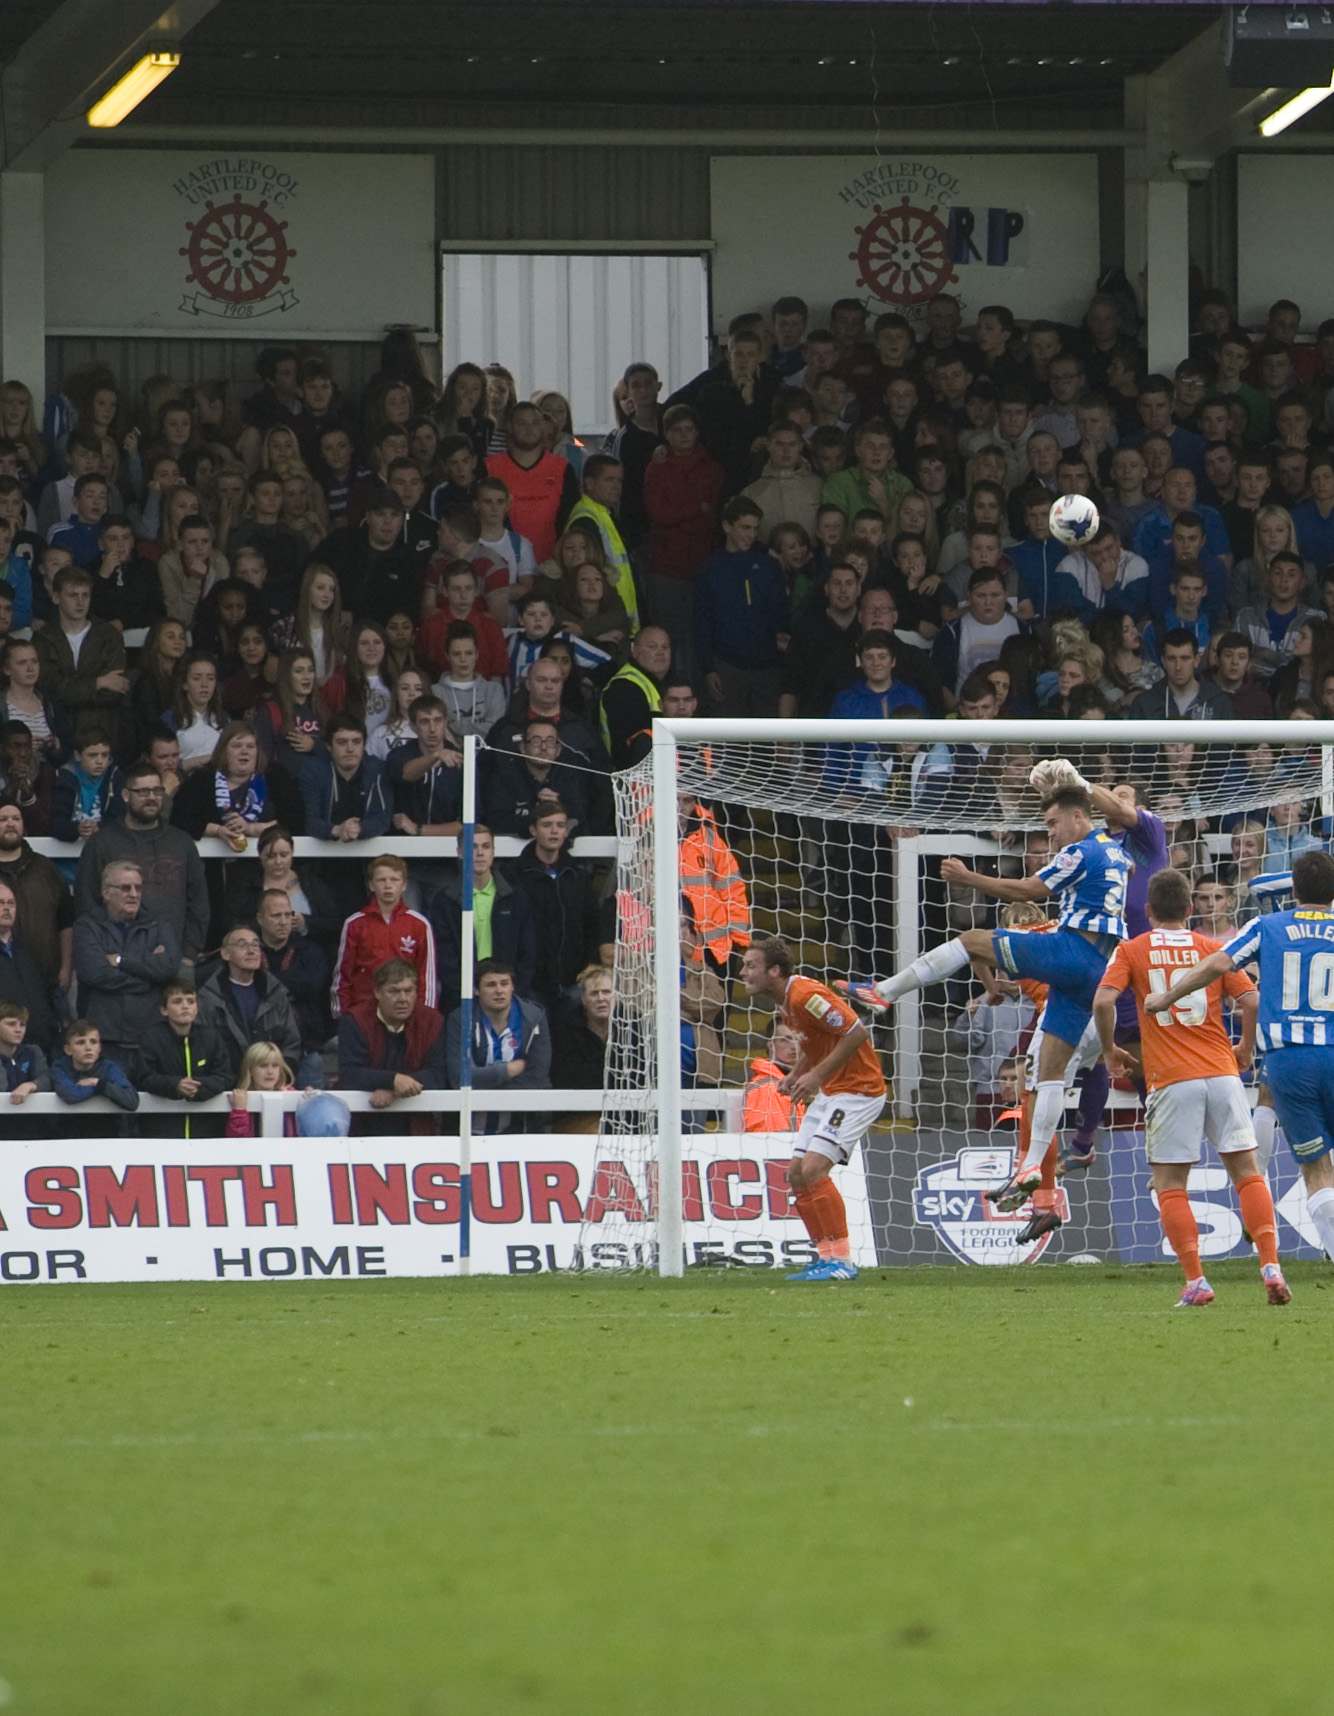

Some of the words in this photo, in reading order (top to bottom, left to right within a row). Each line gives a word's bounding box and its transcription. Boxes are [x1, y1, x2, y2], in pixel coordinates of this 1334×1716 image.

[172, 158, 299, 198] HARTLEPOOL
[185, 175, 258, 205] UNITED
[838, 161, 961, 204] HARTLEPOOL
[855, 178, 919, 209] UNITED
[223, 303, 255, 317] 1908
[1149, 949, 1200, 966] MILLER
[829, 1108, 846, 1129] 8
[25, 1164, 298, 1230] SMITH
[922, 1191, 976, 1221] sky
[1, 1250, 87, 1281] OR
[213, 1246, 387, 1278] HOME
[506, 1240, 820, 1275] BUSIESS
